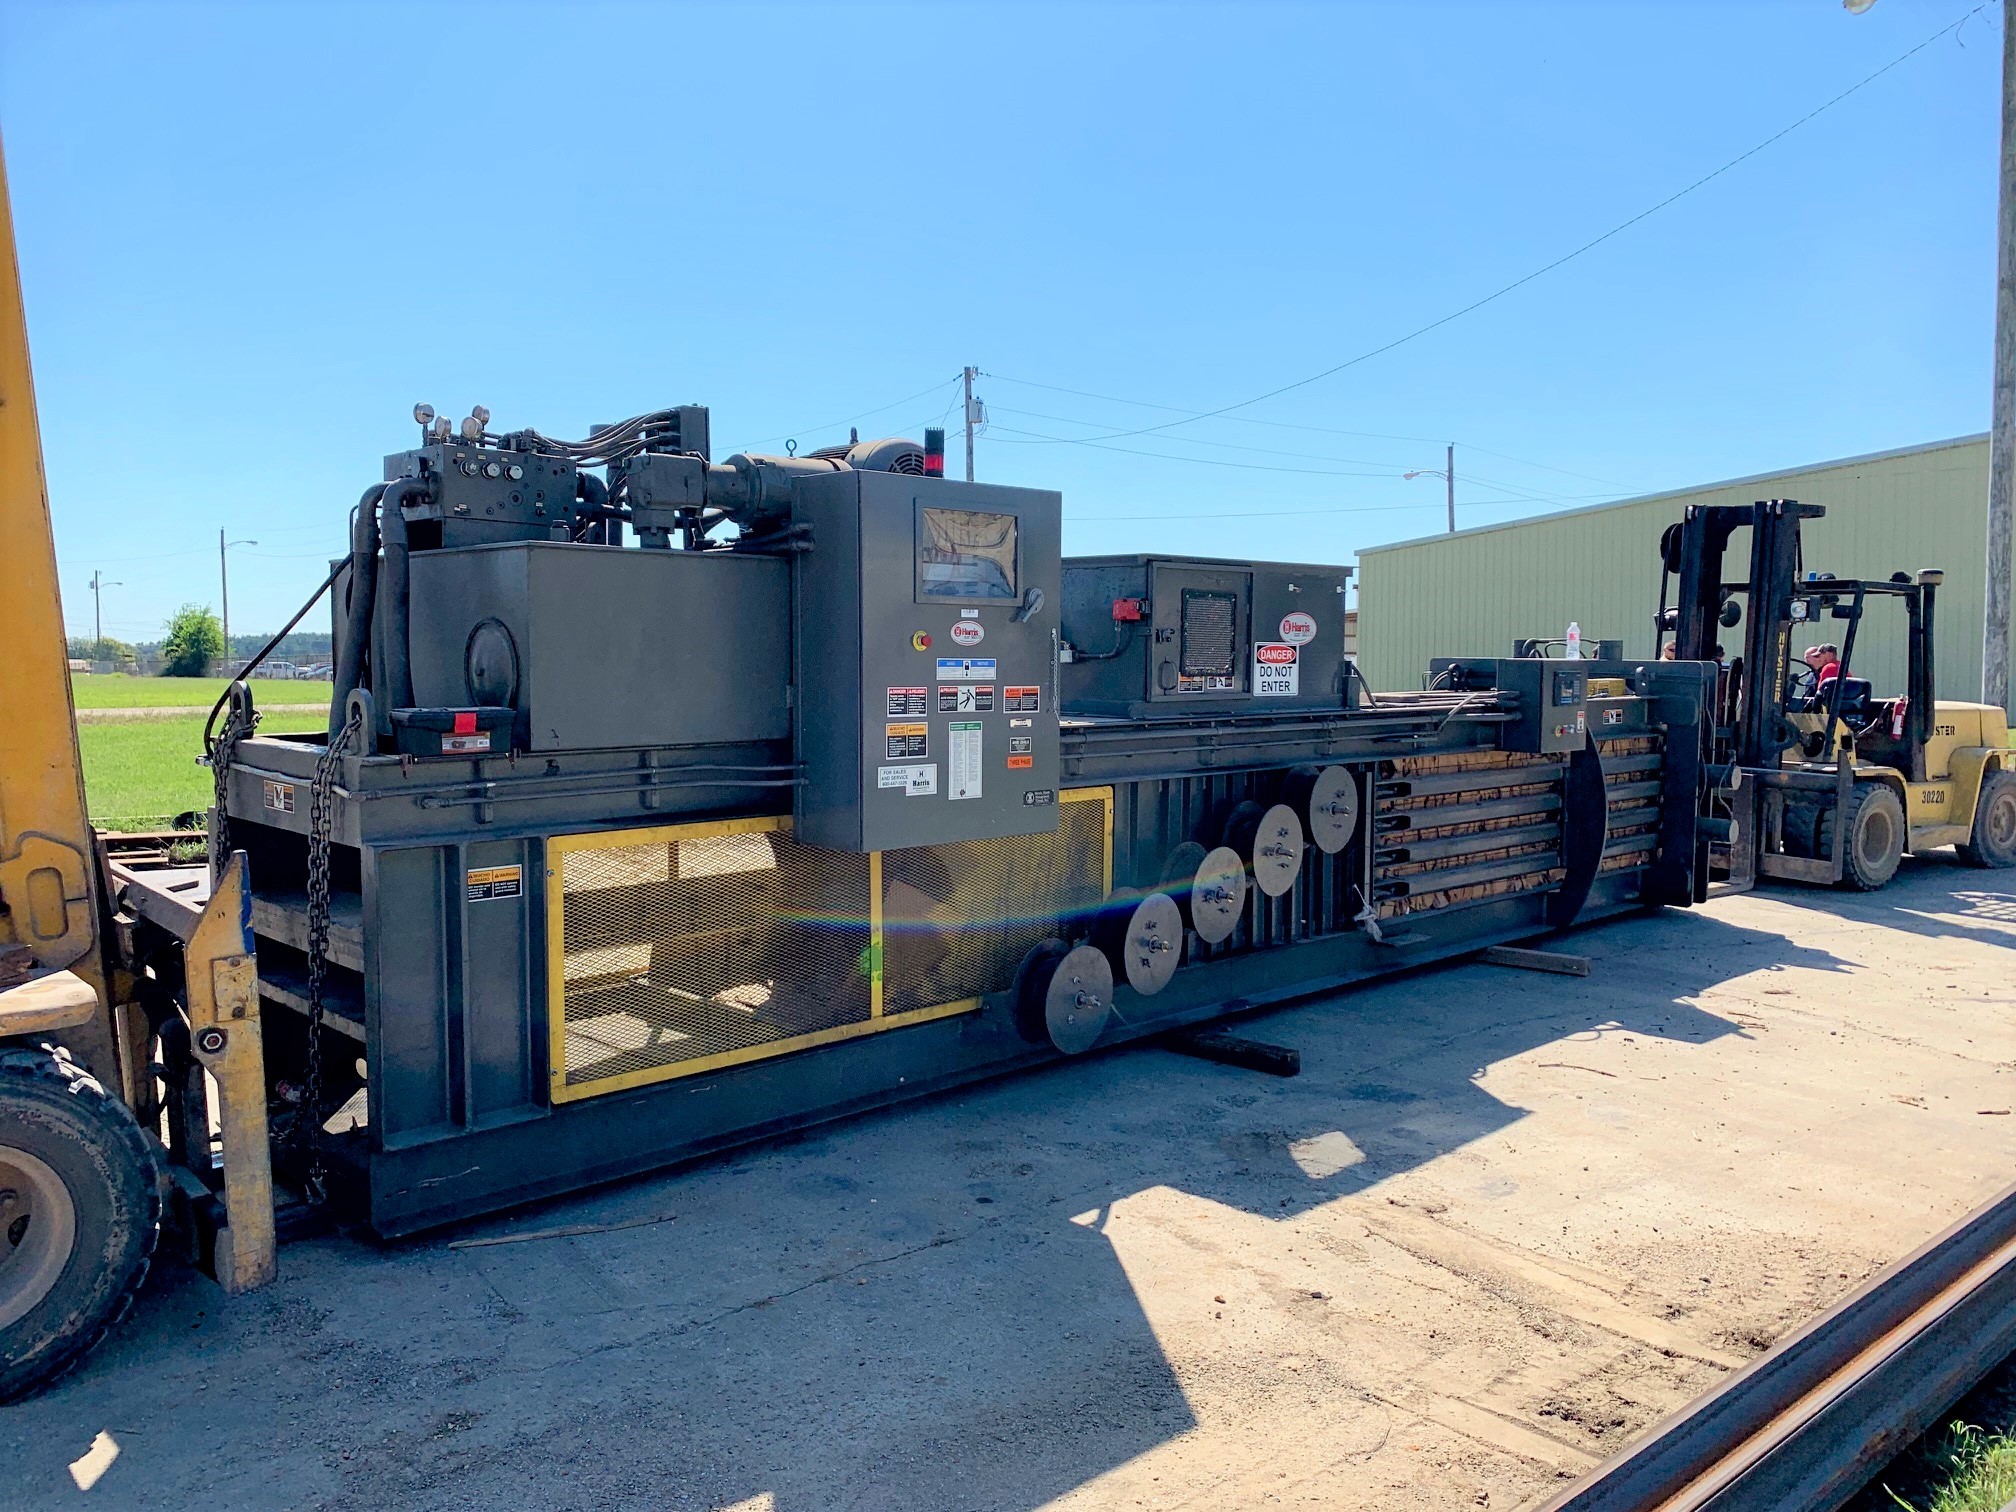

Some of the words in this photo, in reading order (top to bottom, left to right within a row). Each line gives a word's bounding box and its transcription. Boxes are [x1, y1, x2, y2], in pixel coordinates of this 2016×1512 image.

[962, 628, 979, 636] Harris
[1291, 622, 1310, 632] Harris
[1260, 650, 1292, 660] DANGER
[1260, 666, 1272, 677] DO
[1275, 666, 1292, 677] NOT
[1774, 632, 1785, 703] HYSTER
[1261, 681, 1290, 692] ENTER
[1935, 725, 1955, 736] STER
[912, 779, 930, 787] Harris
[1921, 790, 1945, 804] 30220
